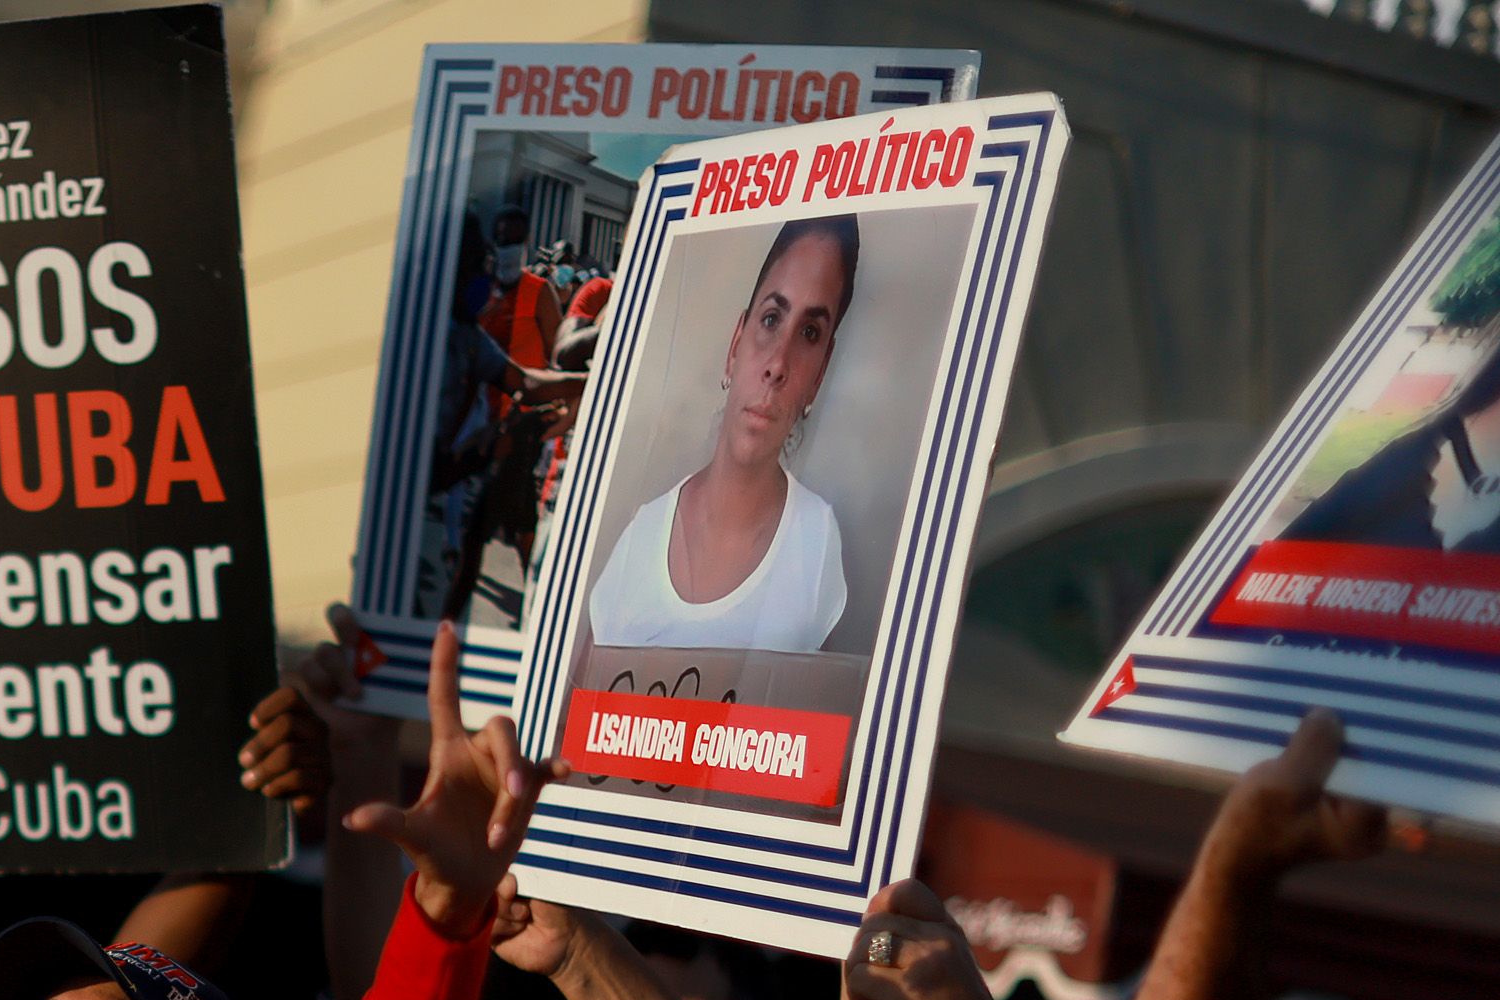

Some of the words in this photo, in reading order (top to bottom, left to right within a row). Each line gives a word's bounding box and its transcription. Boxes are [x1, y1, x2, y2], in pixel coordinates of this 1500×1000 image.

[493, 64, 633, 118] PRESO
[648, 53, 860, 123] POLÍTICO
[691, 146, 799, 217] PRESO
[801, 117, 975, 202] POLÍTICO
[586, 711, 687, 763] LISANDRA
[691, 723, 807, 779] GONGORA
